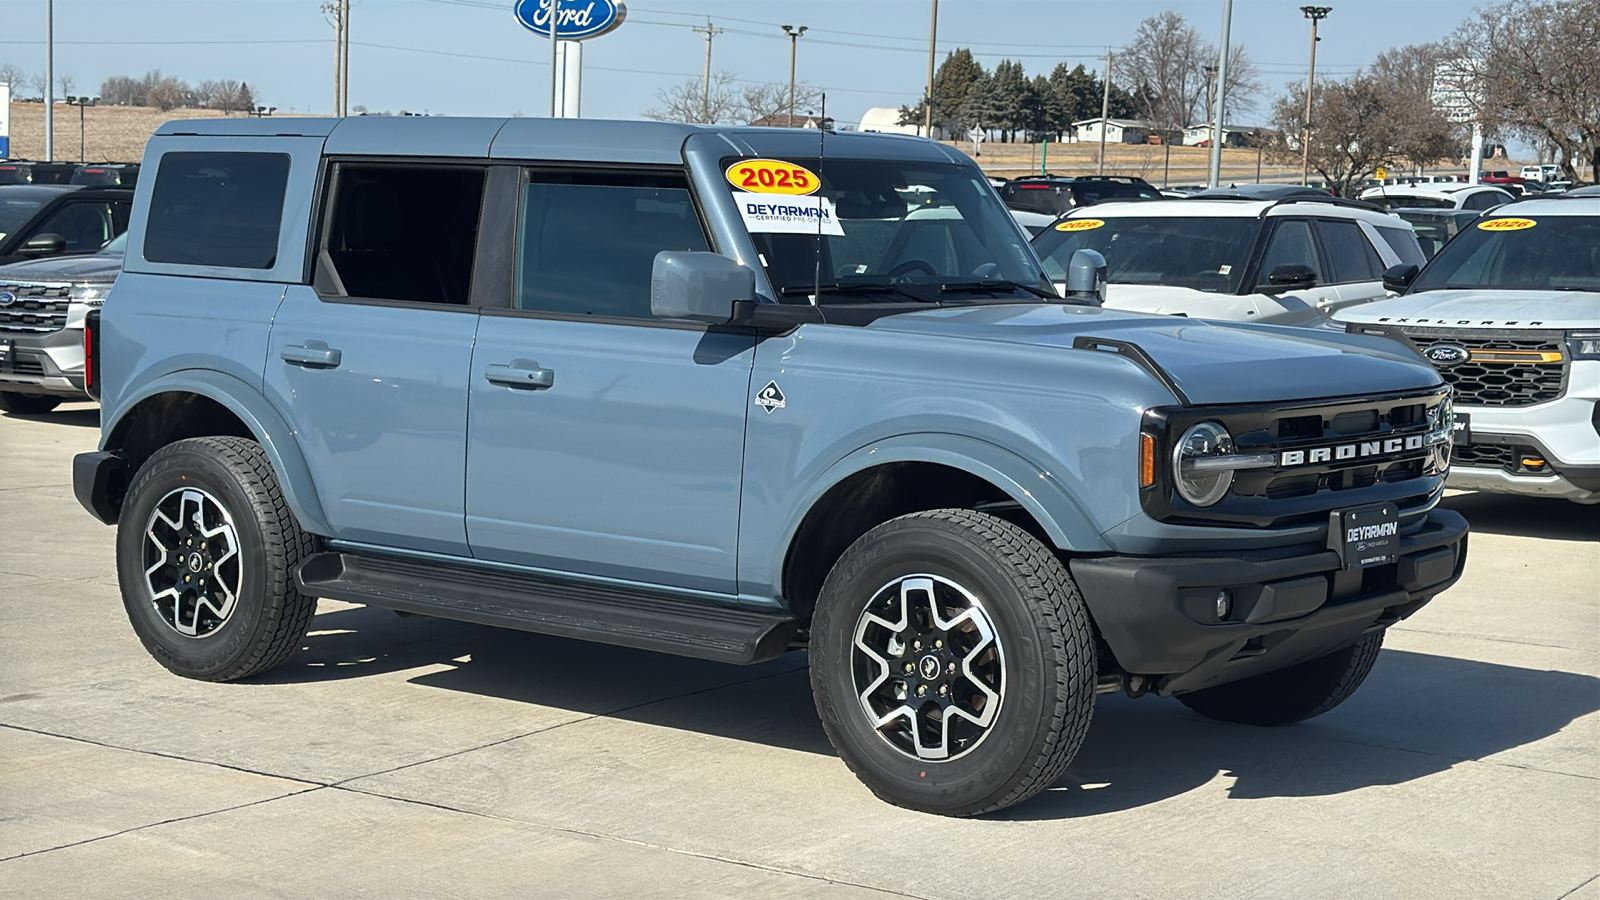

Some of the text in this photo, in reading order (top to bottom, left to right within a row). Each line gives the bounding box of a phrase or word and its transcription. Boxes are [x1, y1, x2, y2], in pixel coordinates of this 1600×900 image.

[739, 168, 810, 188] 2025
[746, 203, 830, 219] DEYARMAN
[755, 214, 792, 222] CERTIFIED
[1060, 221, 1100, 229] 2026
[1379, 317, 1543, 326] EXPLORER
[1432, 349, 1457, 359] Ford
[1281, 435, 1423, 466] BRONCO
[1347, 521, 1397, 543] DEYARMAN
